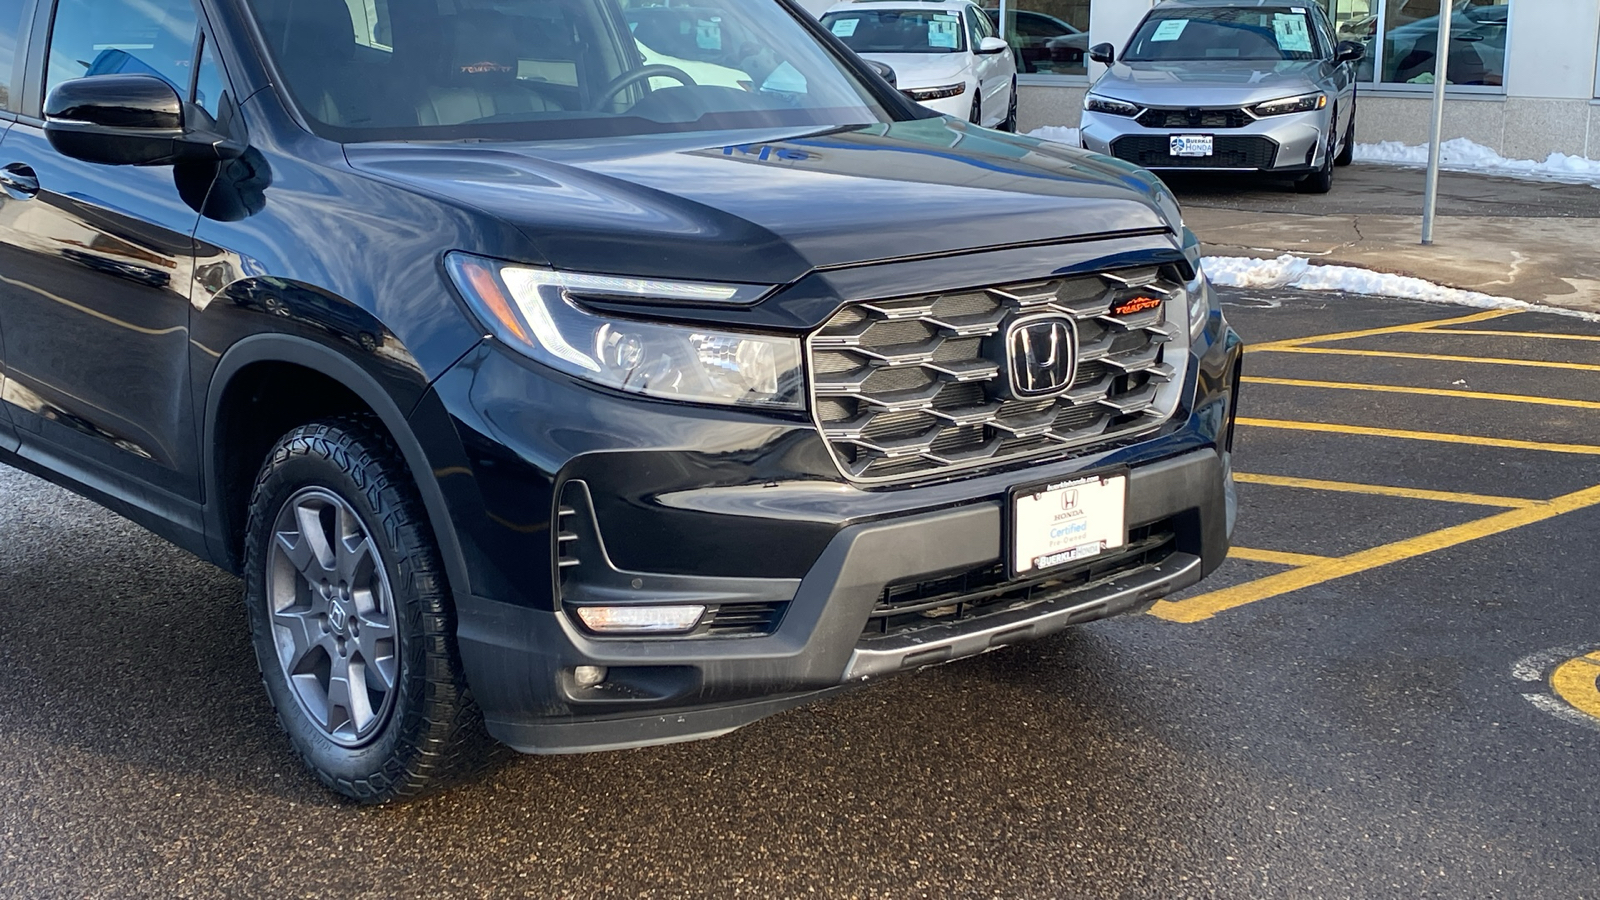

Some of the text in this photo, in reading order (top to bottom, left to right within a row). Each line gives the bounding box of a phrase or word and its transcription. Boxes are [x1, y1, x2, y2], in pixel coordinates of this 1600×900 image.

[1185, 143, 1212, 151] HONDA
[1054, 509, 1084, 521] HONDA
[1050, 520, 1087, 538] Certified
[1049, 532, 1087, 547] Pre-Owned
